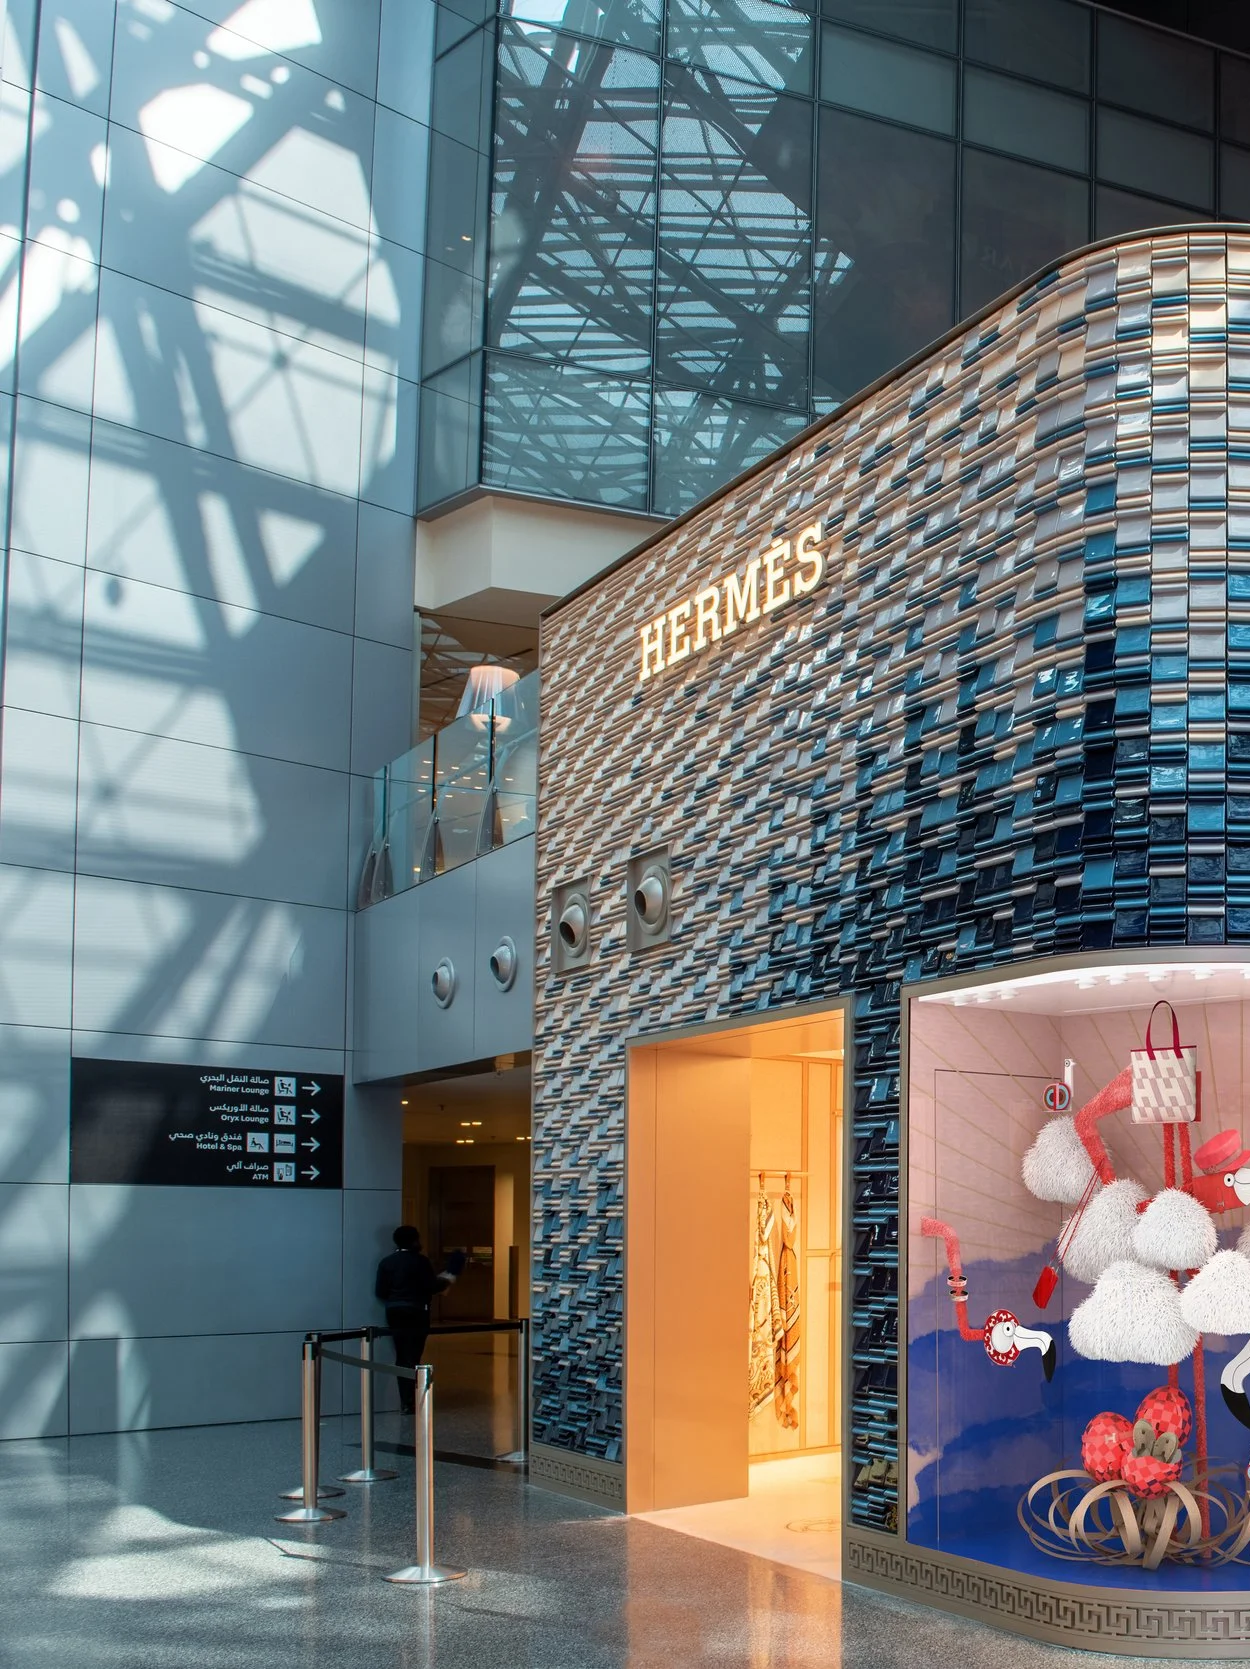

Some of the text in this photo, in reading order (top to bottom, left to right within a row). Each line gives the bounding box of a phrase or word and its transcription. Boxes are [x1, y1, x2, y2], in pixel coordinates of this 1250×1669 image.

[637, 521, 825, 682] HERMÈS
[200, 1074, 270, 1084] صالة النقل البحري
[209, 1084, 270, 1096] Mariner Lounge
[249, 1104, 269, 1112] صالة
[221, 1114, 269, 1124] Oryx Lounge
[168, 1132, 243, 1142] فندق ونادي صحي
[196, 1142, 242, 1152] Hotel & Spa
[226, 1160, 269, 1172] صراف آلي
[252, 1173, 269, 1181] ATM
